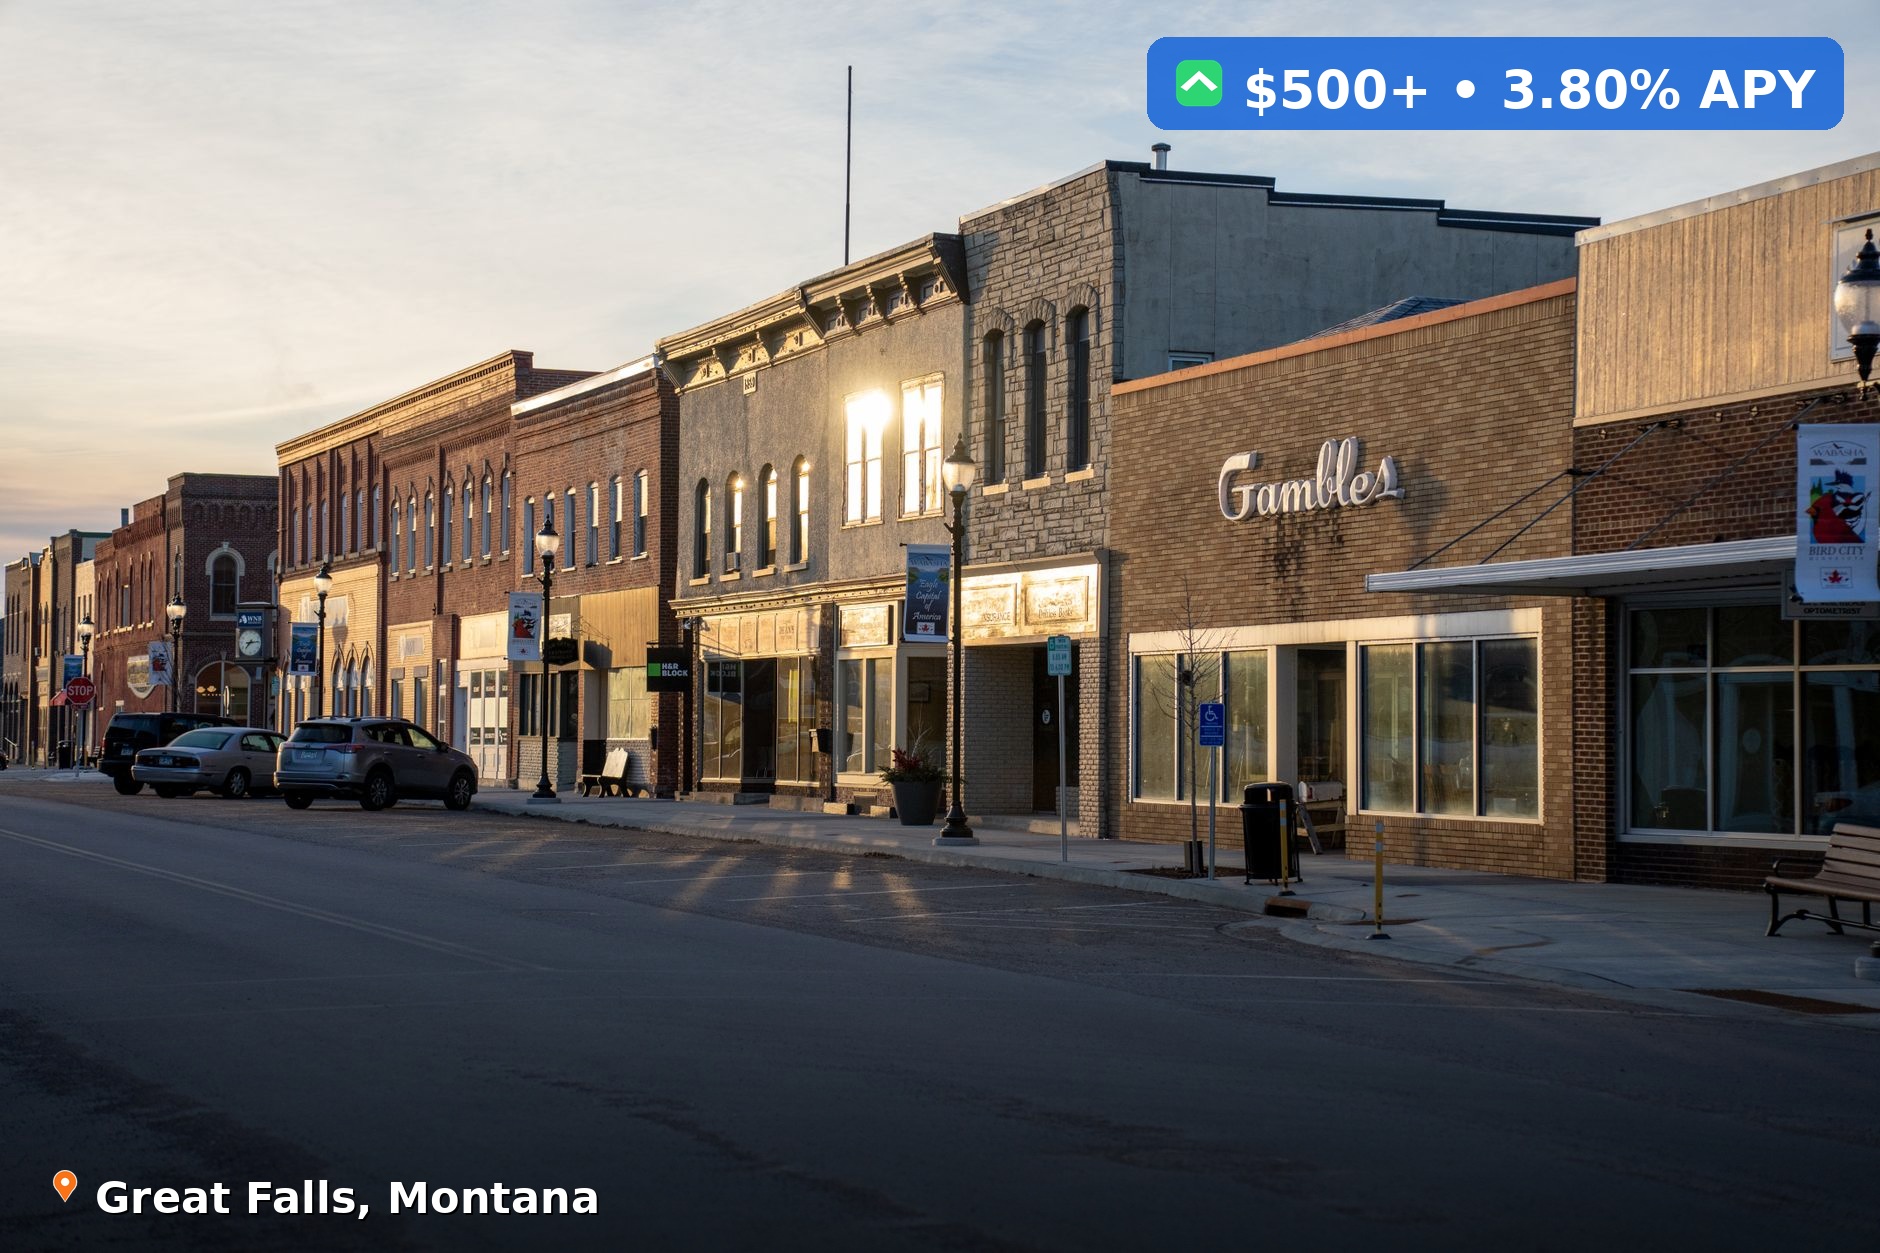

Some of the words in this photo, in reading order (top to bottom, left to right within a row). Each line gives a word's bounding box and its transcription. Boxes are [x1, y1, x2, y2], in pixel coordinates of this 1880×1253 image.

[1813, 449, 1865, 457] WABASHA
[1218, 436, 1405, 522] Gambles
[1809, 546, 1836, 556] BIRD
[1838, 546, 1866, 556] CITY
[920, 579, 938, 593] Eagle
[915, 590, 942, 604] Capital
[924, 599, 934, 612] of
[912, 611, 942, 622] America
[68, 686, 93, 695] STOP
